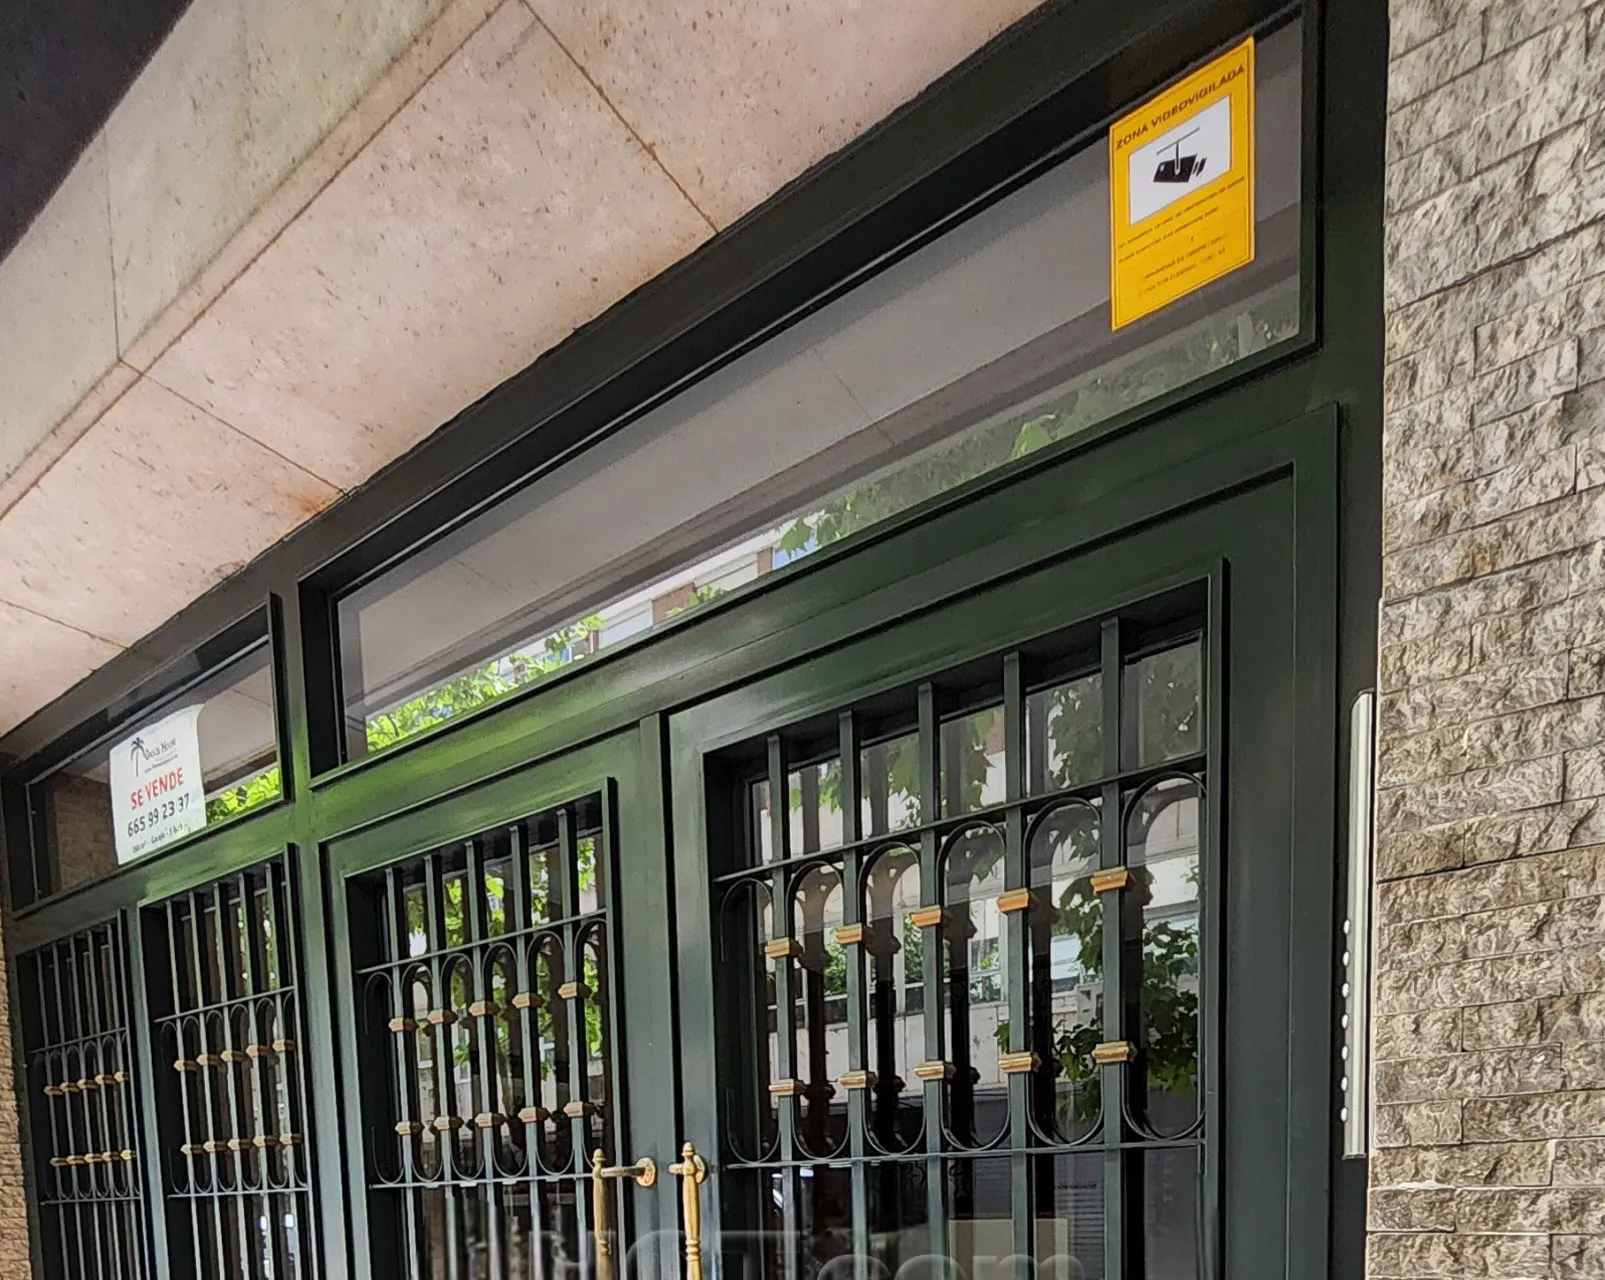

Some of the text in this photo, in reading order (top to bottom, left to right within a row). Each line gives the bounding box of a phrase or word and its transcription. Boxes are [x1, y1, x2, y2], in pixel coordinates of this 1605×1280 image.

[1116, 66, 1246, 152] ZONA VIDEOVIGILADA
[131, 767, 184, 811] SE VENDE
[127, 792, 190, 837] 665 99 23 37
